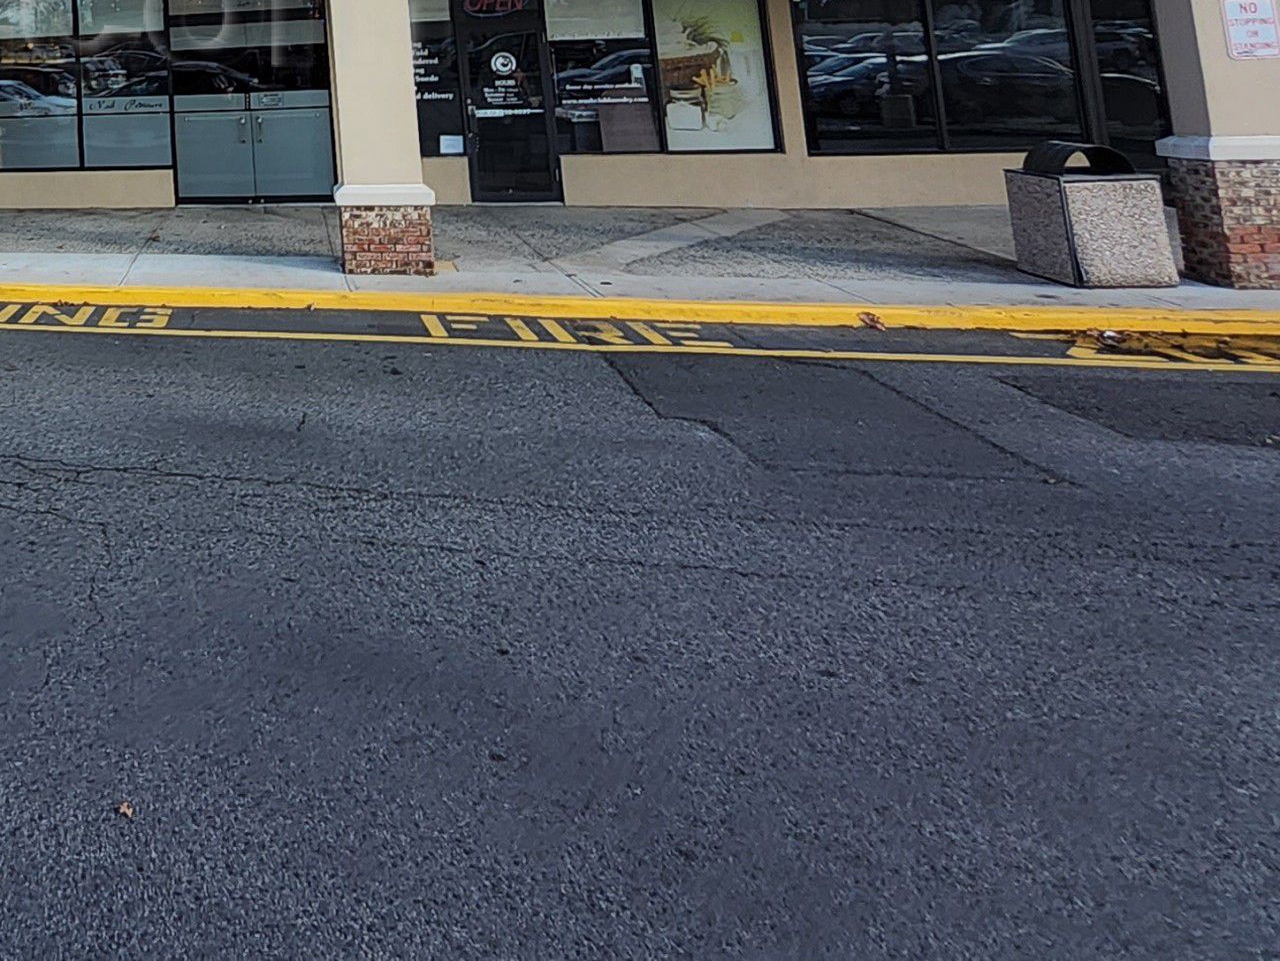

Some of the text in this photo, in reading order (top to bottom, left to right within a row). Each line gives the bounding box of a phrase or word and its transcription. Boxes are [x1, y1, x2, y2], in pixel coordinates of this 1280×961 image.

[1239, 2, 1258, 15] NO
[423, 91, 454, 100] delivery
[420, 314, 734, 348] FIRE
